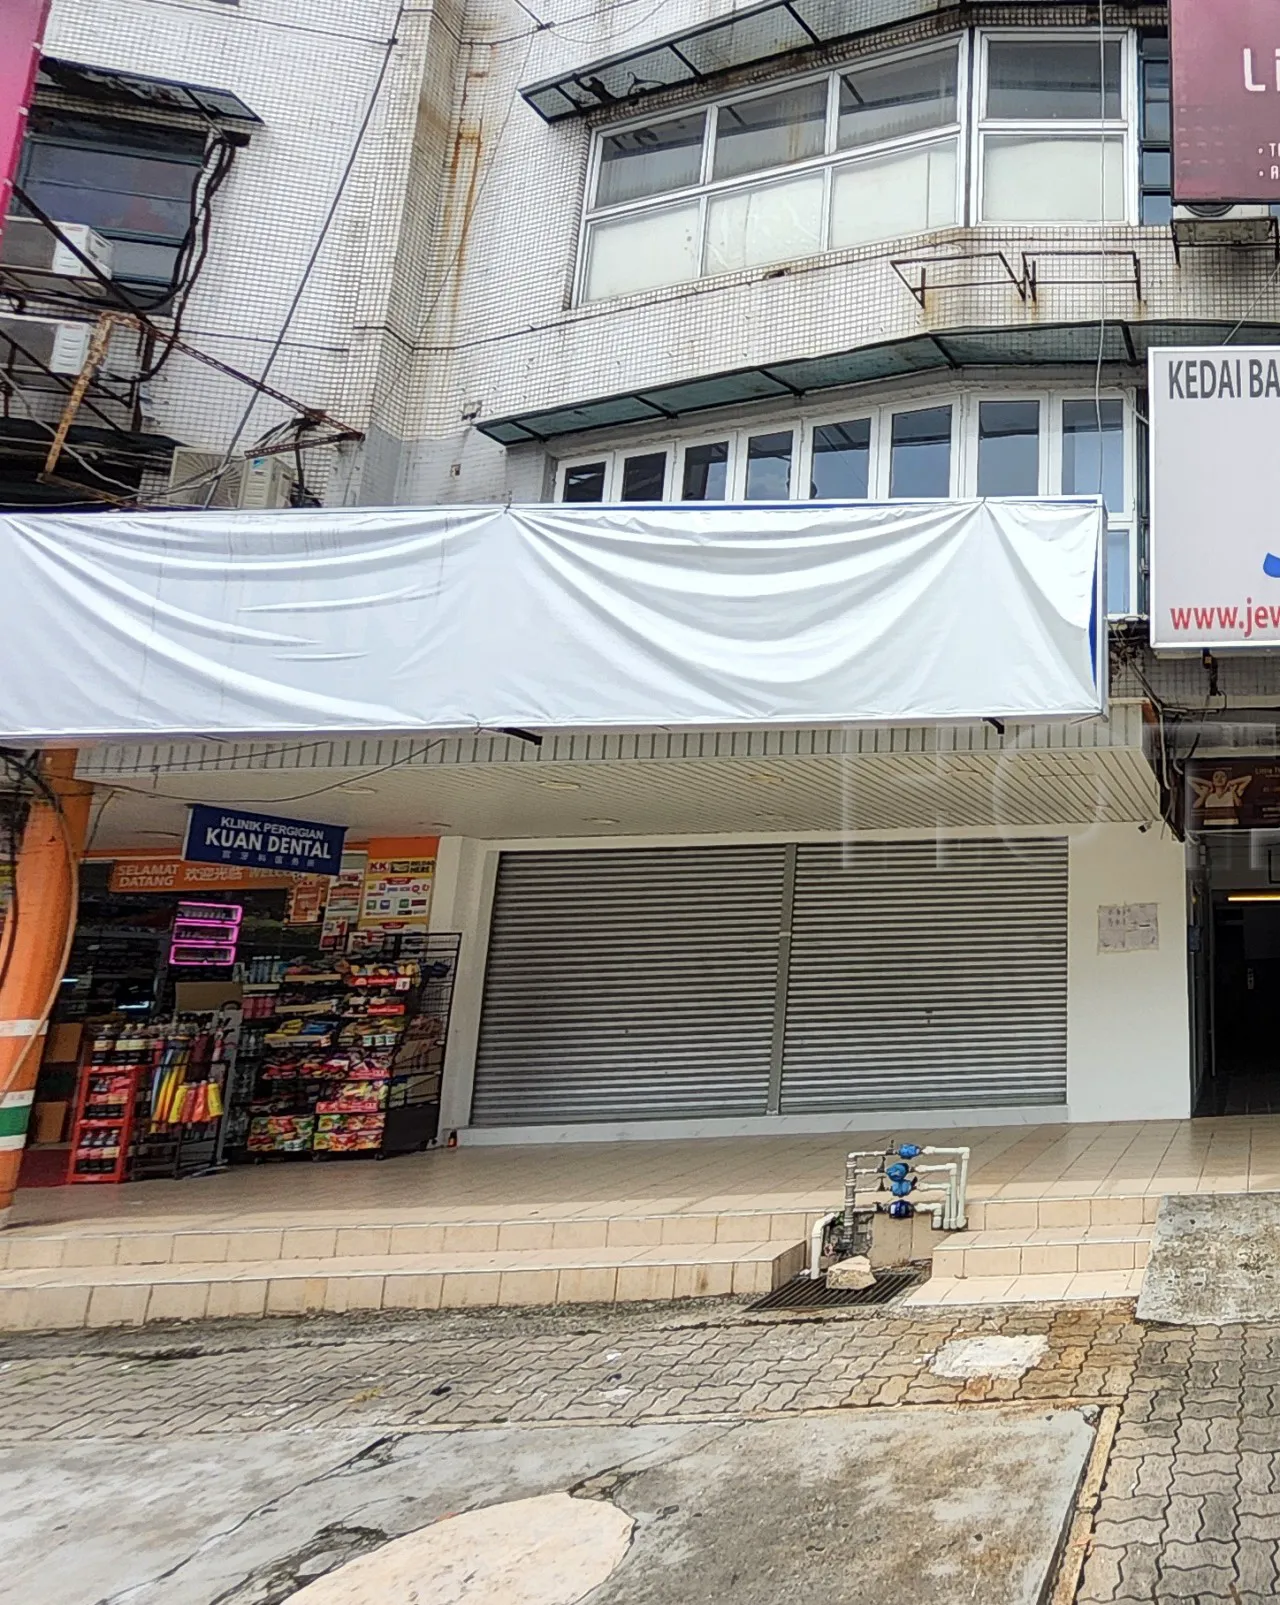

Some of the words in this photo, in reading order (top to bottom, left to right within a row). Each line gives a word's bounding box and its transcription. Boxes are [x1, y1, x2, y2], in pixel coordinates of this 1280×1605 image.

[1168, 358, 1243, 400] KEDAI
[220, 816, 262, 833] KLINIK
[263, 821, 325, 841] PERGIGIAN
[205, 827, 264, 852] KUAN
[267, 835, 333, 860] DENTAL
[118, 863, 180, 877] SELAMAT
[184, 866, 244, 882] 欢迎光临
[118, 875, 175, 888] DATANG
